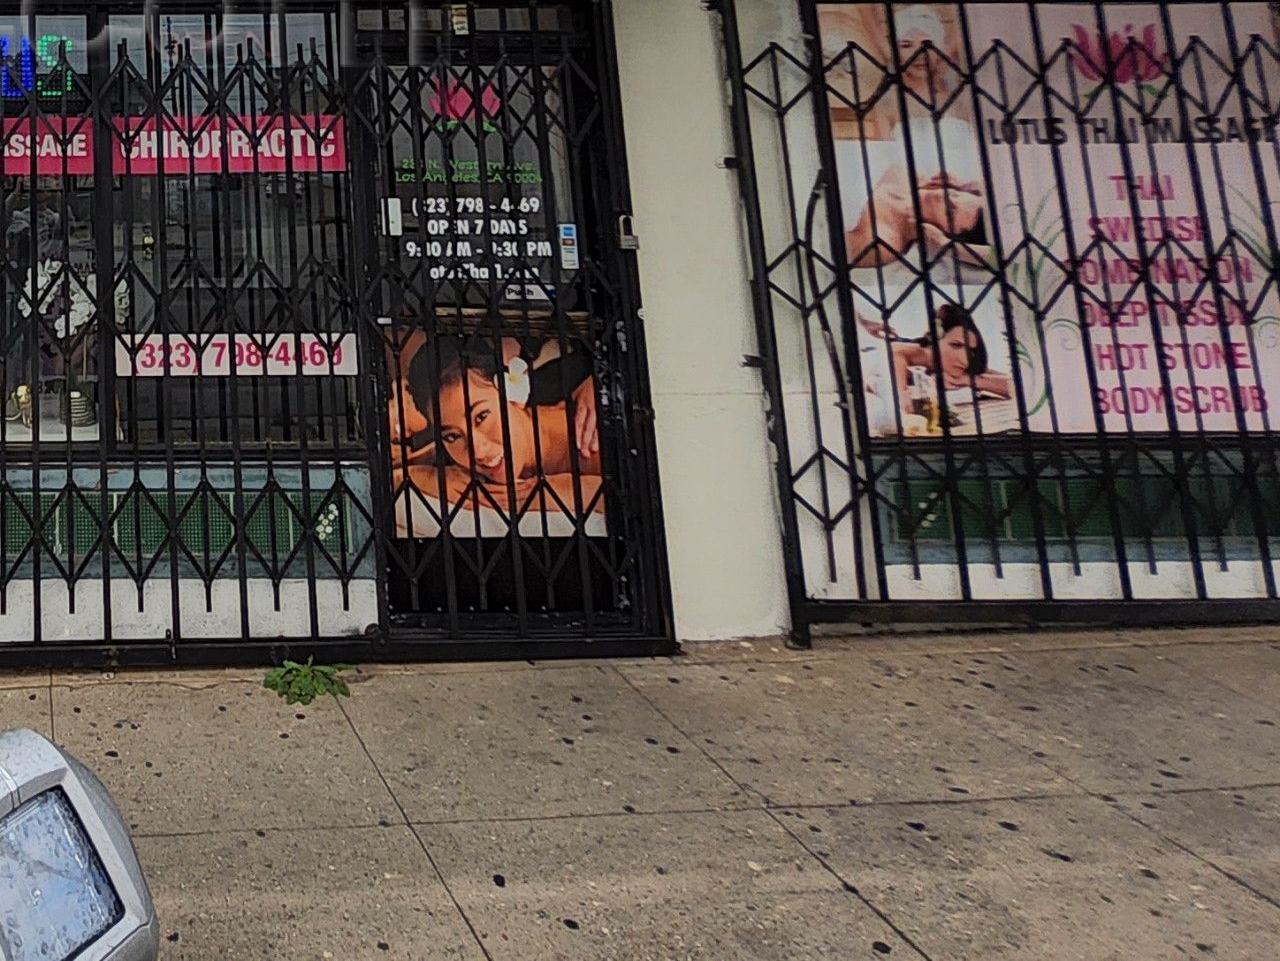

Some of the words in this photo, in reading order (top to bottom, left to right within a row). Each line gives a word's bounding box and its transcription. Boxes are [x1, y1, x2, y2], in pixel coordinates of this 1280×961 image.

[1077, 117, 1140, 145] THI
[456, 197, 484, 214] 798
[500, 198, 541, 214] 469
[474, 219, 484, 235] 7
[526, 241, 553, 258] PM
[507, 287, 534, 297] Puh
[1095, 343, 1149, 371] HOT
[1160, 342, 1251, 370] STONE
[1097, 387, 1166, 414] BODY
[1174, 385, 1268, 413] SCRUB
